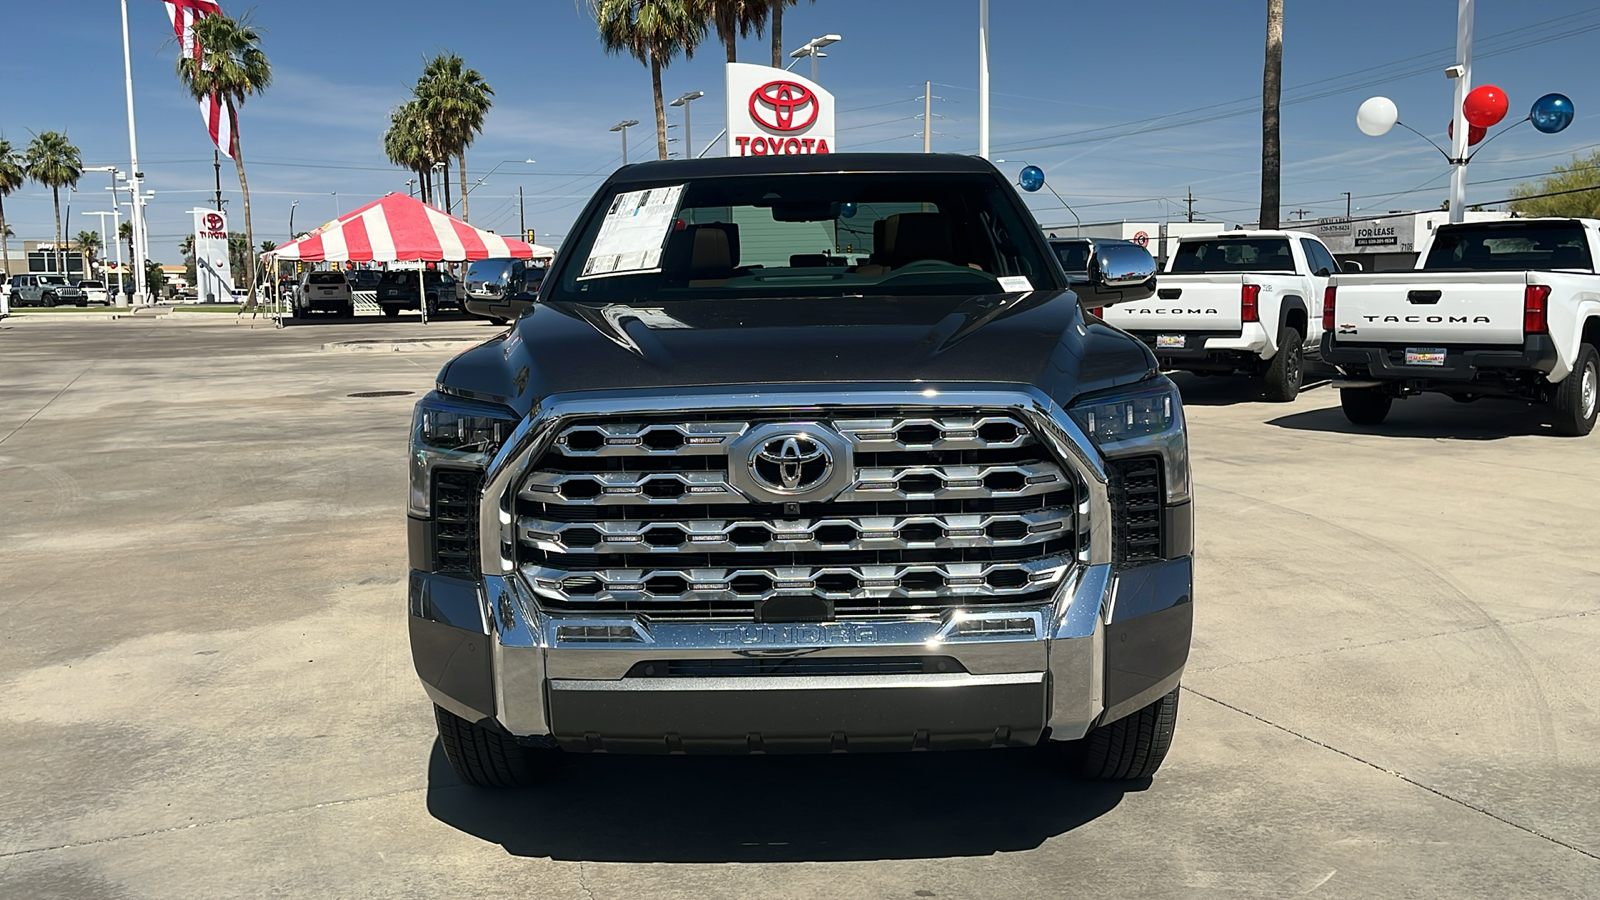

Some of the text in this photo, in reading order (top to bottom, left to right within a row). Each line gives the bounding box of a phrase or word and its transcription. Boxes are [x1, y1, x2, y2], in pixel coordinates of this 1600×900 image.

[735, 136, 829, 156] TOYOTA
[1357, 227, 1395, 237] FOR LEASE
[1363, 315, 1491, 324] TACOMA
[710, 625, 878, 644] TUNDRA
